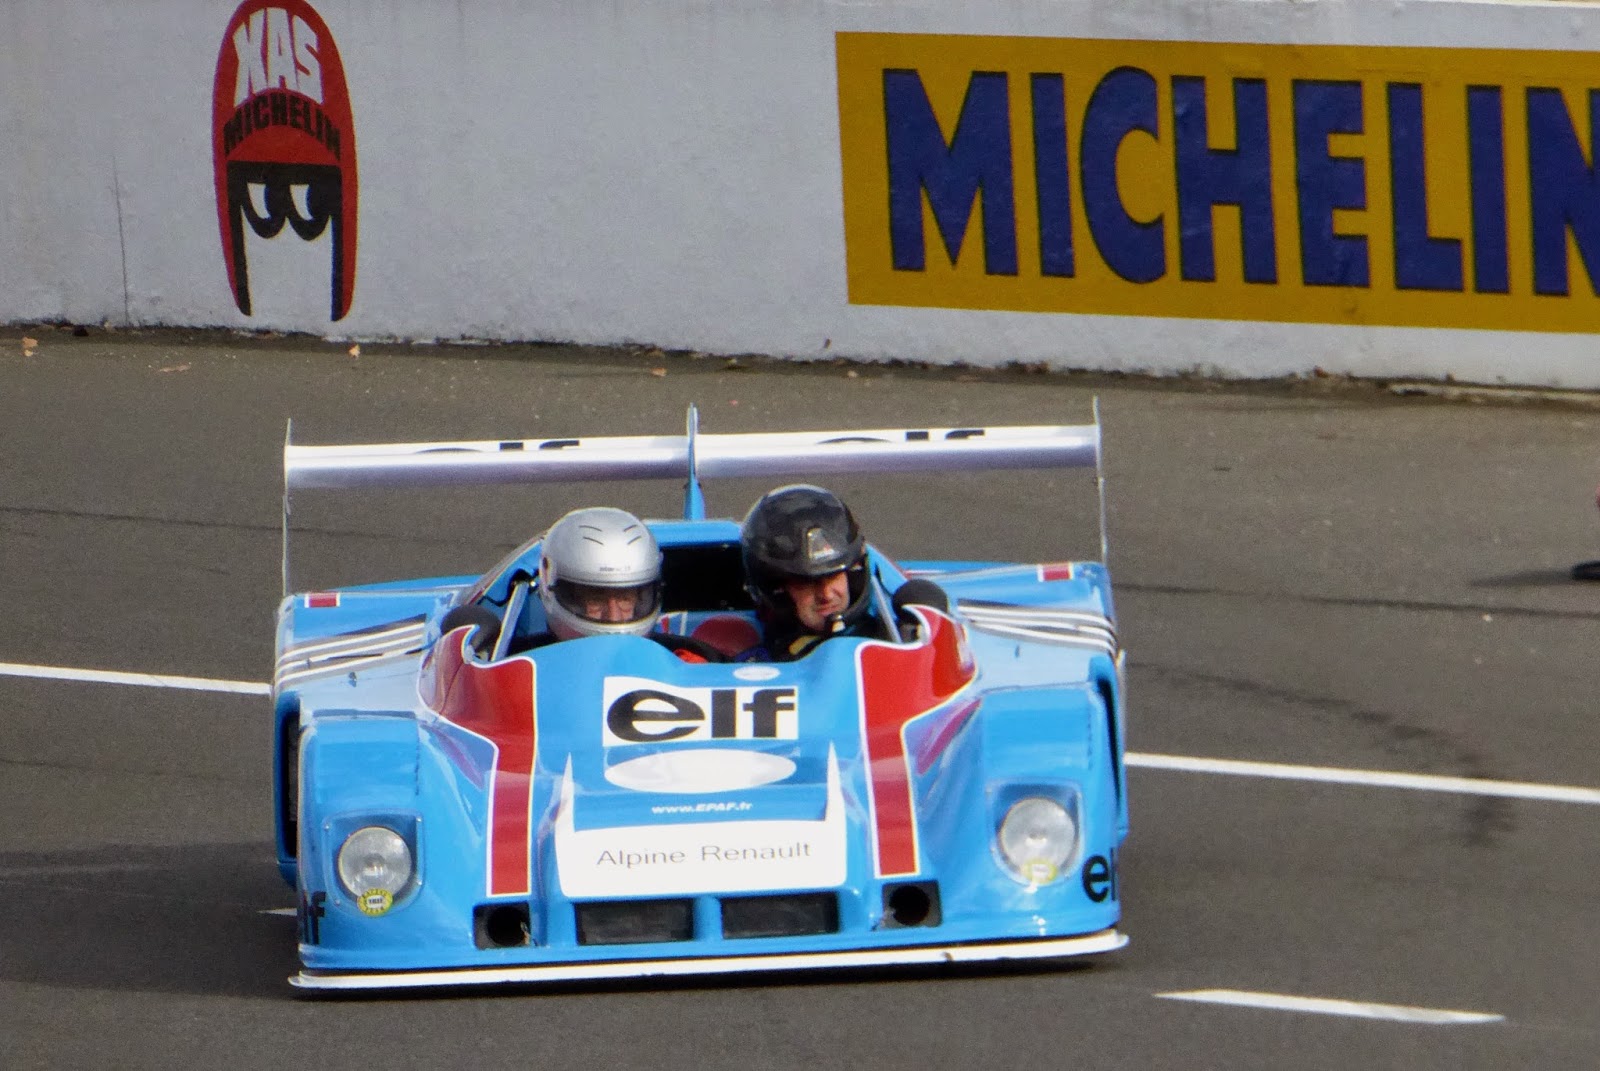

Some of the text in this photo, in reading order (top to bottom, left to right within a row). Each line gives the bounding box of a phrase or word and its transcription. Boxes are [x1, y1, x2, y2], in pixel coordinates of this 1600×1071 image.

[233, 7, 325, 108] XAS
[223, 91, 342, 161] MICHELIN
[882, 65, 1600, 298] MICHELIN
[606, 688, 796, 743] elf
[651, 802, 753, 815] www.EPAF.fr
[596, 842, 812, 869] Alpine Renault
